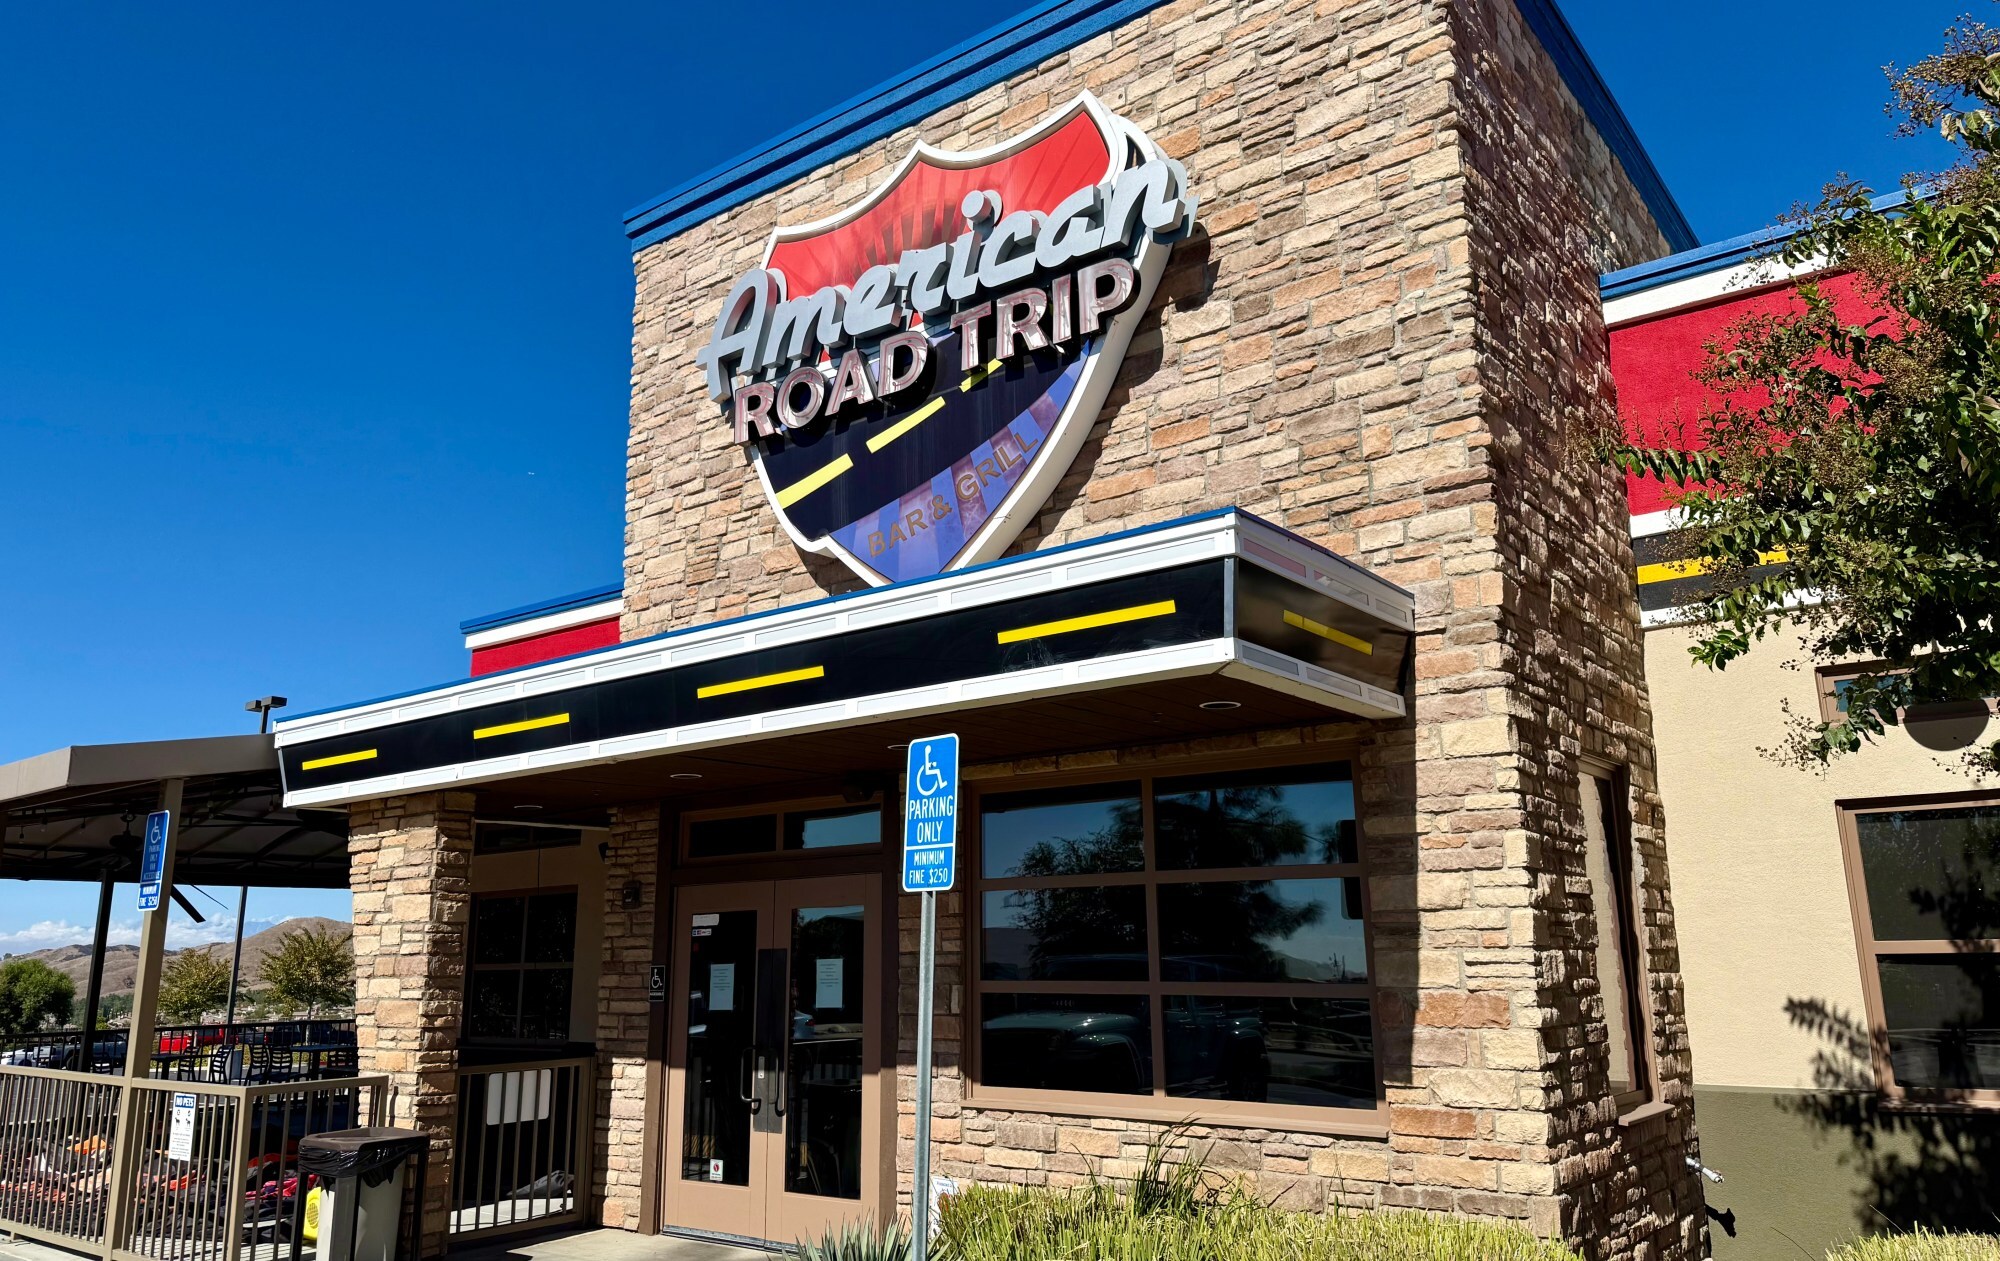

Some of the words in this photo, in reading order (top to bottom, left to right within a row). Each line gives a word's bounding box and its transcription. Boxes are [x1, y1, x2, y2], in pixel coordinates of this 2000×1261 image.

[696, 158, 1199, 403] American
[733, 329, 929, 446] ROAD
[949, 257, 1141, 372] TRIP
[867, 508, 928, 558] BAR
[931, 494, 952, 520] &
[956, 432, 1038, 501] GRILL
[909, 795, 953, 819] PARKING
[917, 821, 943, 843] ONLY
[914, 851, 944, 866] MINIMUM
[909, 869, 925, 884] FINE
[929, 867, 948, 885] $250
[176, 1096, 183, 1106] NO
[183, 1097, 194, 1107] PETS
